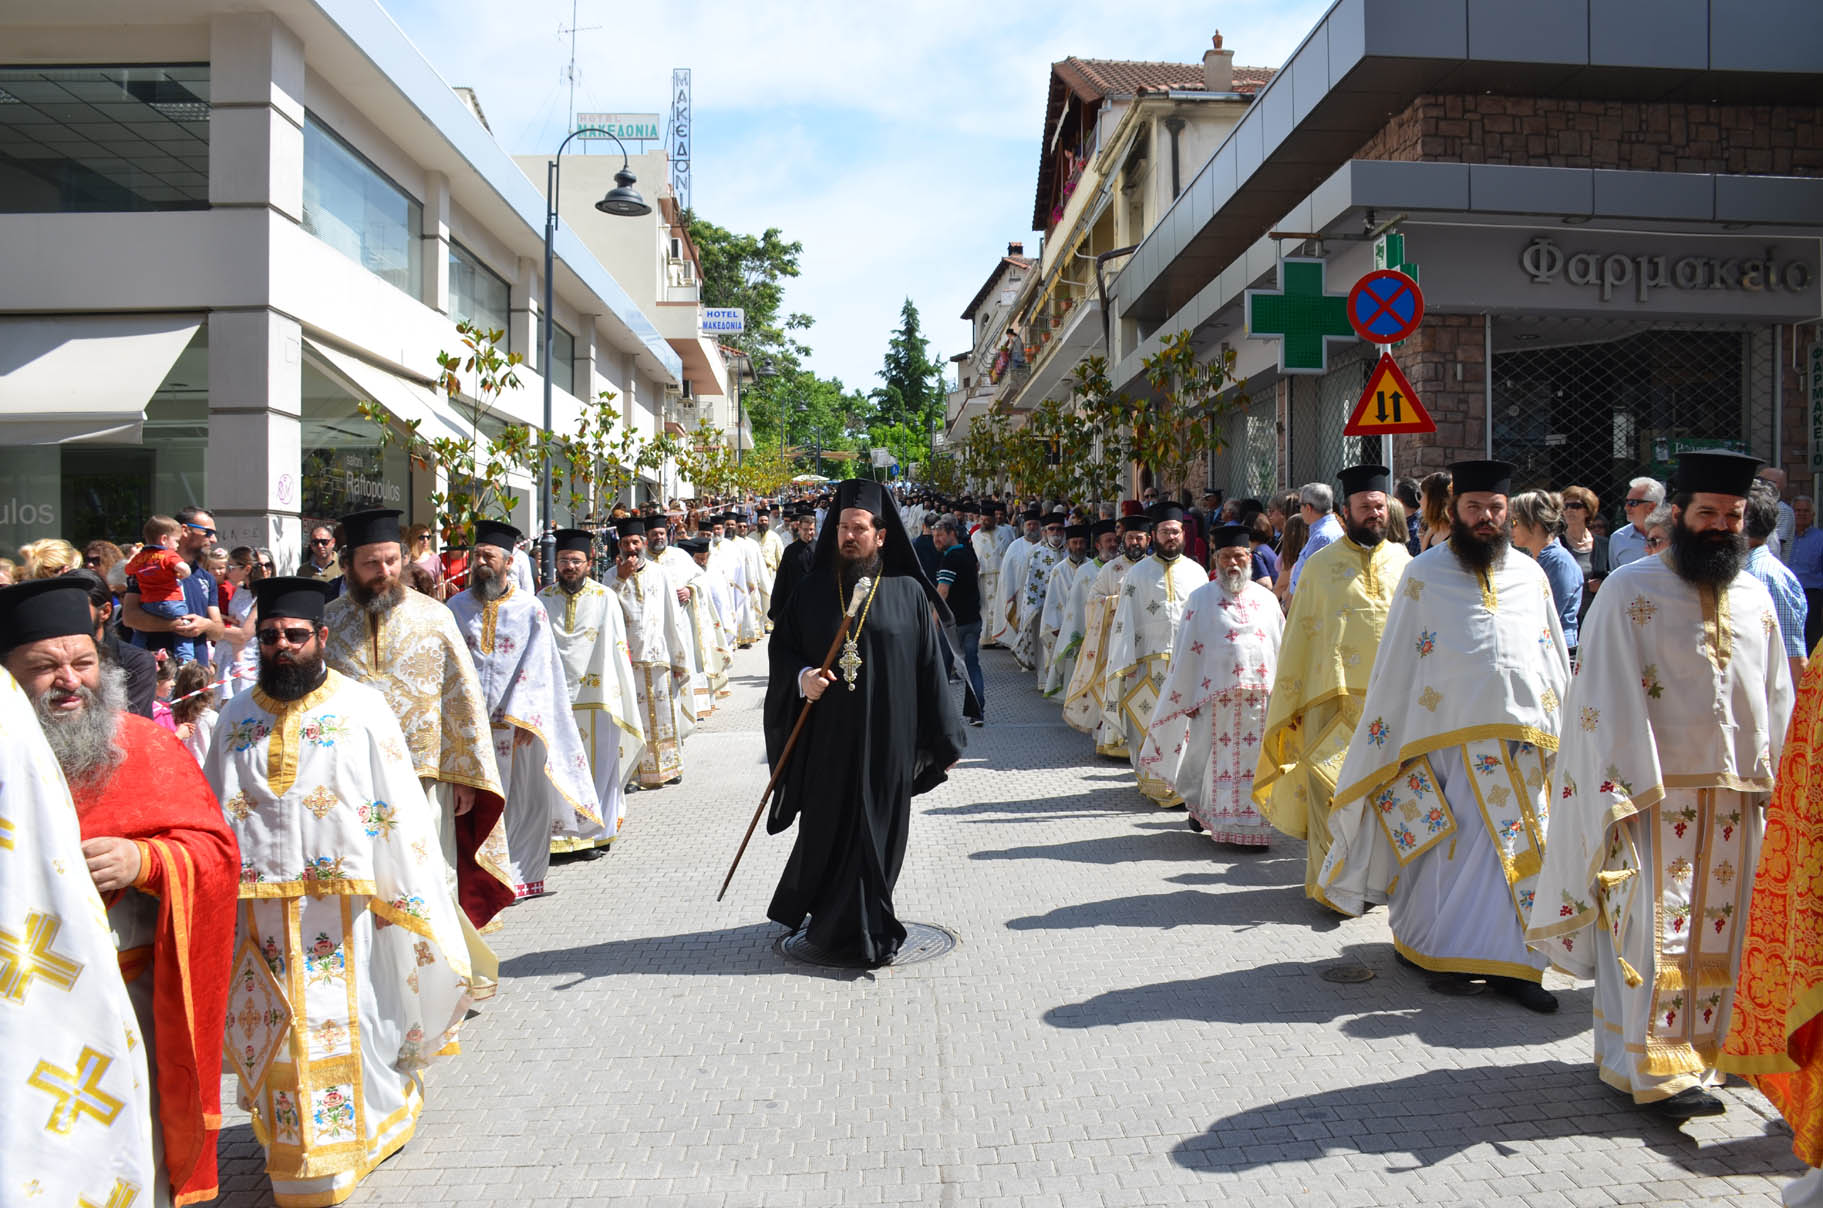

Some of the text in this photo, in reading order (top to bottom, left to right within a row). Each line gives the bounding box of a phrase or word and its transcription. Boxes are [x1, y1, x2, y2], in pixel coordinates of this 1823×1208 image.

[579, 114, 621, 123] HOTEL
[675, 71, 690, 209] ΜΑΚΕΔΟΝΙ
[1521, 236, 1813, 303] Φαρμακείο
[346, 471, 401, 503] Raftopoulos
